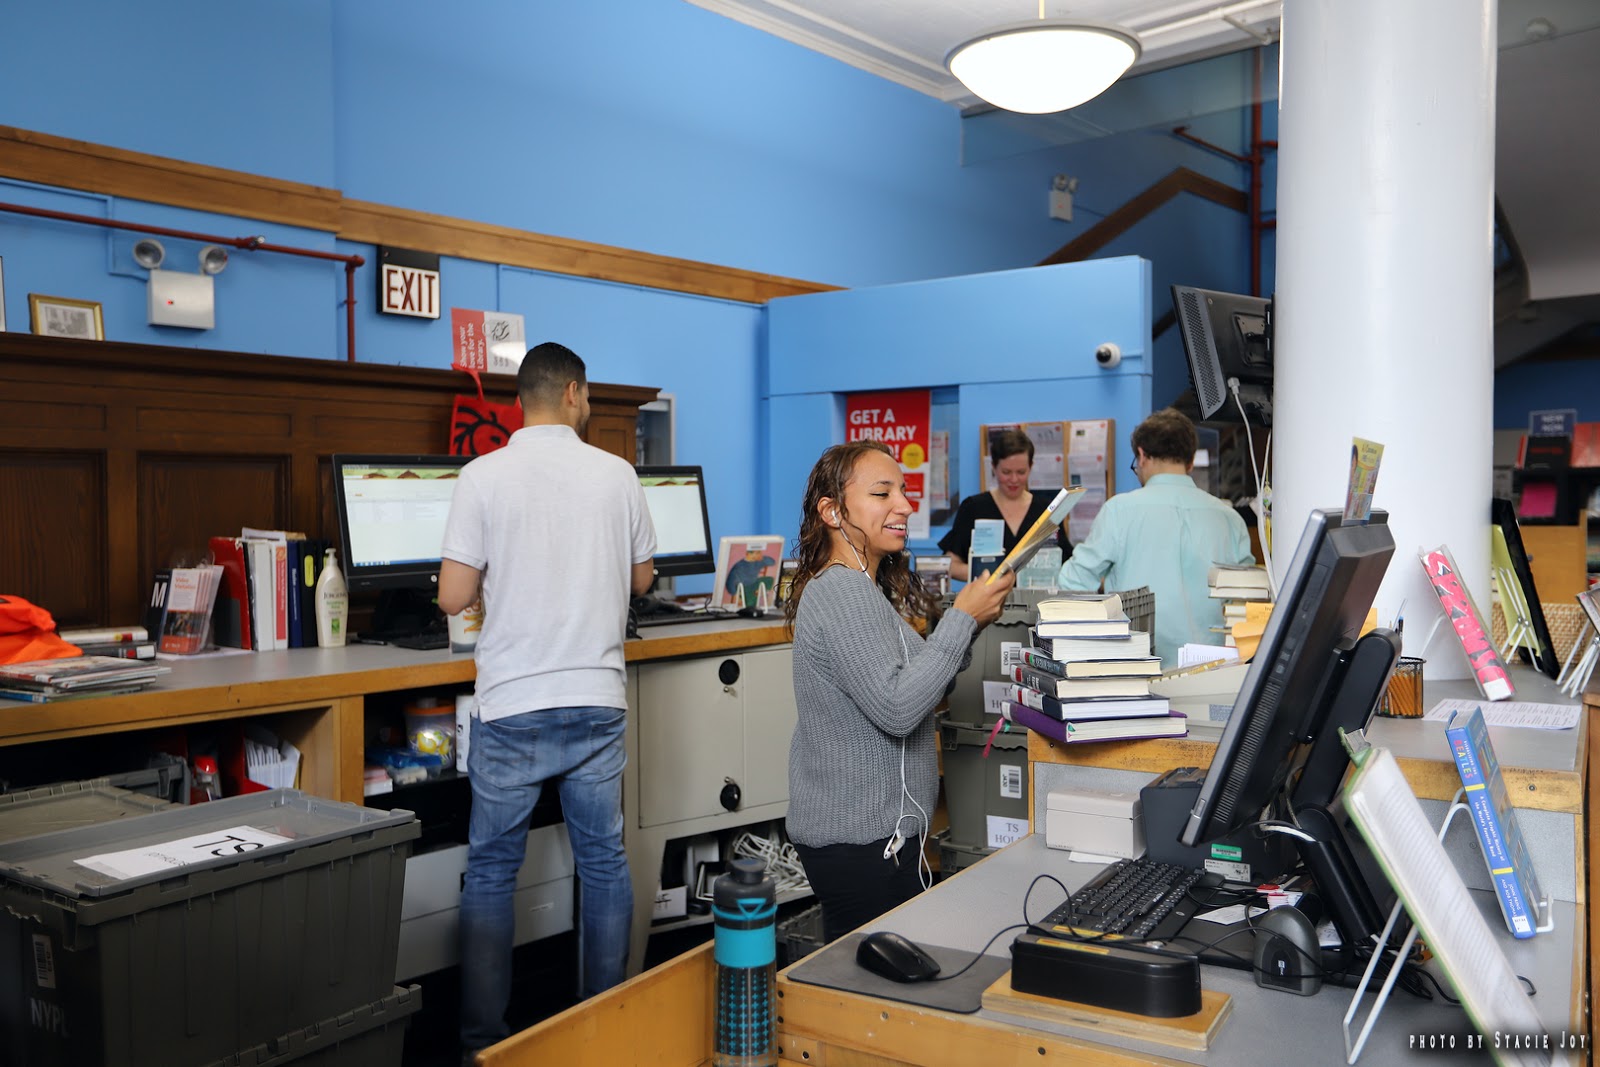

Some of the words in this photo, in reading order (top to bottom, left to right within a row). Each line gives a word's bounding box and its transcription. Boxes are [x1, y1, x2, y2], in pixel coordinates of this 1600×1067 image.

[387, 269, 435, 313] EXIT
[460, 326, 468, 345] your
[468, 351, 476, 369] love
[850, 409, 880, 424] GET
[884, 408, 896, 423] A
[850, 425, 916, 442] LIBRARY
[1454, 740, 1473, 778] BEATLES
[1006, 822, 1019, 832] TS
[1478, 810, 1486, 827] World's
[1483, 828, 1492, 845] Favorite
[1481, 800, 1490, 820] Complete
[1488, 822, 1496, 838] Graphic
[193, 835, 264, 857] TS
[1508, 884, 1516, 896] JOHN
[31, 998, 70, 1038] NYPL
